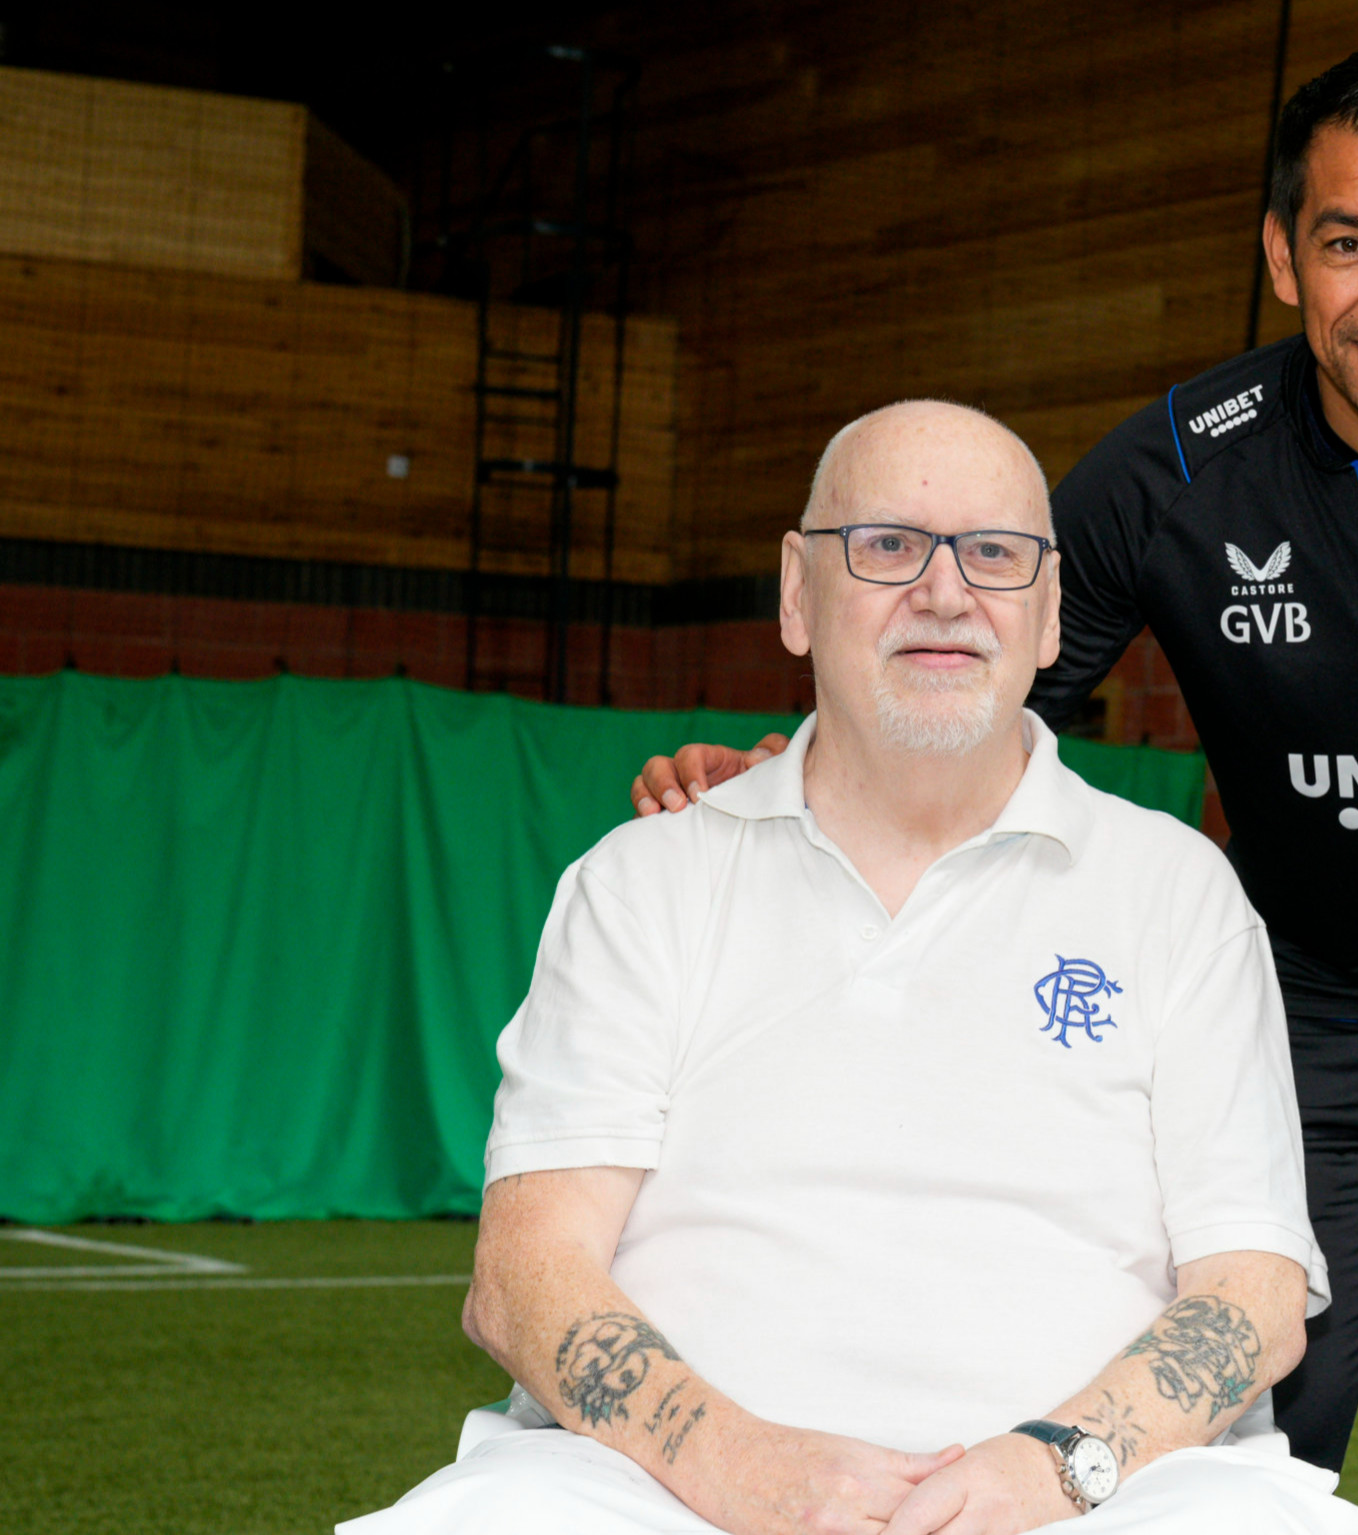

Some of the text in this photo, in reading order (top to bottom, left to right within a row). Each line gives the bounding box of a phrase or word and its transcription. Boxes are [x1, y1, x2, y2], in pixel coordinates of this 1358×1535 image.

[1188, 384, 1264, 434] UNIBET
[1231, 583, 1295, 596] CASTORE
[1220, 602, 1312, 644] GVB
